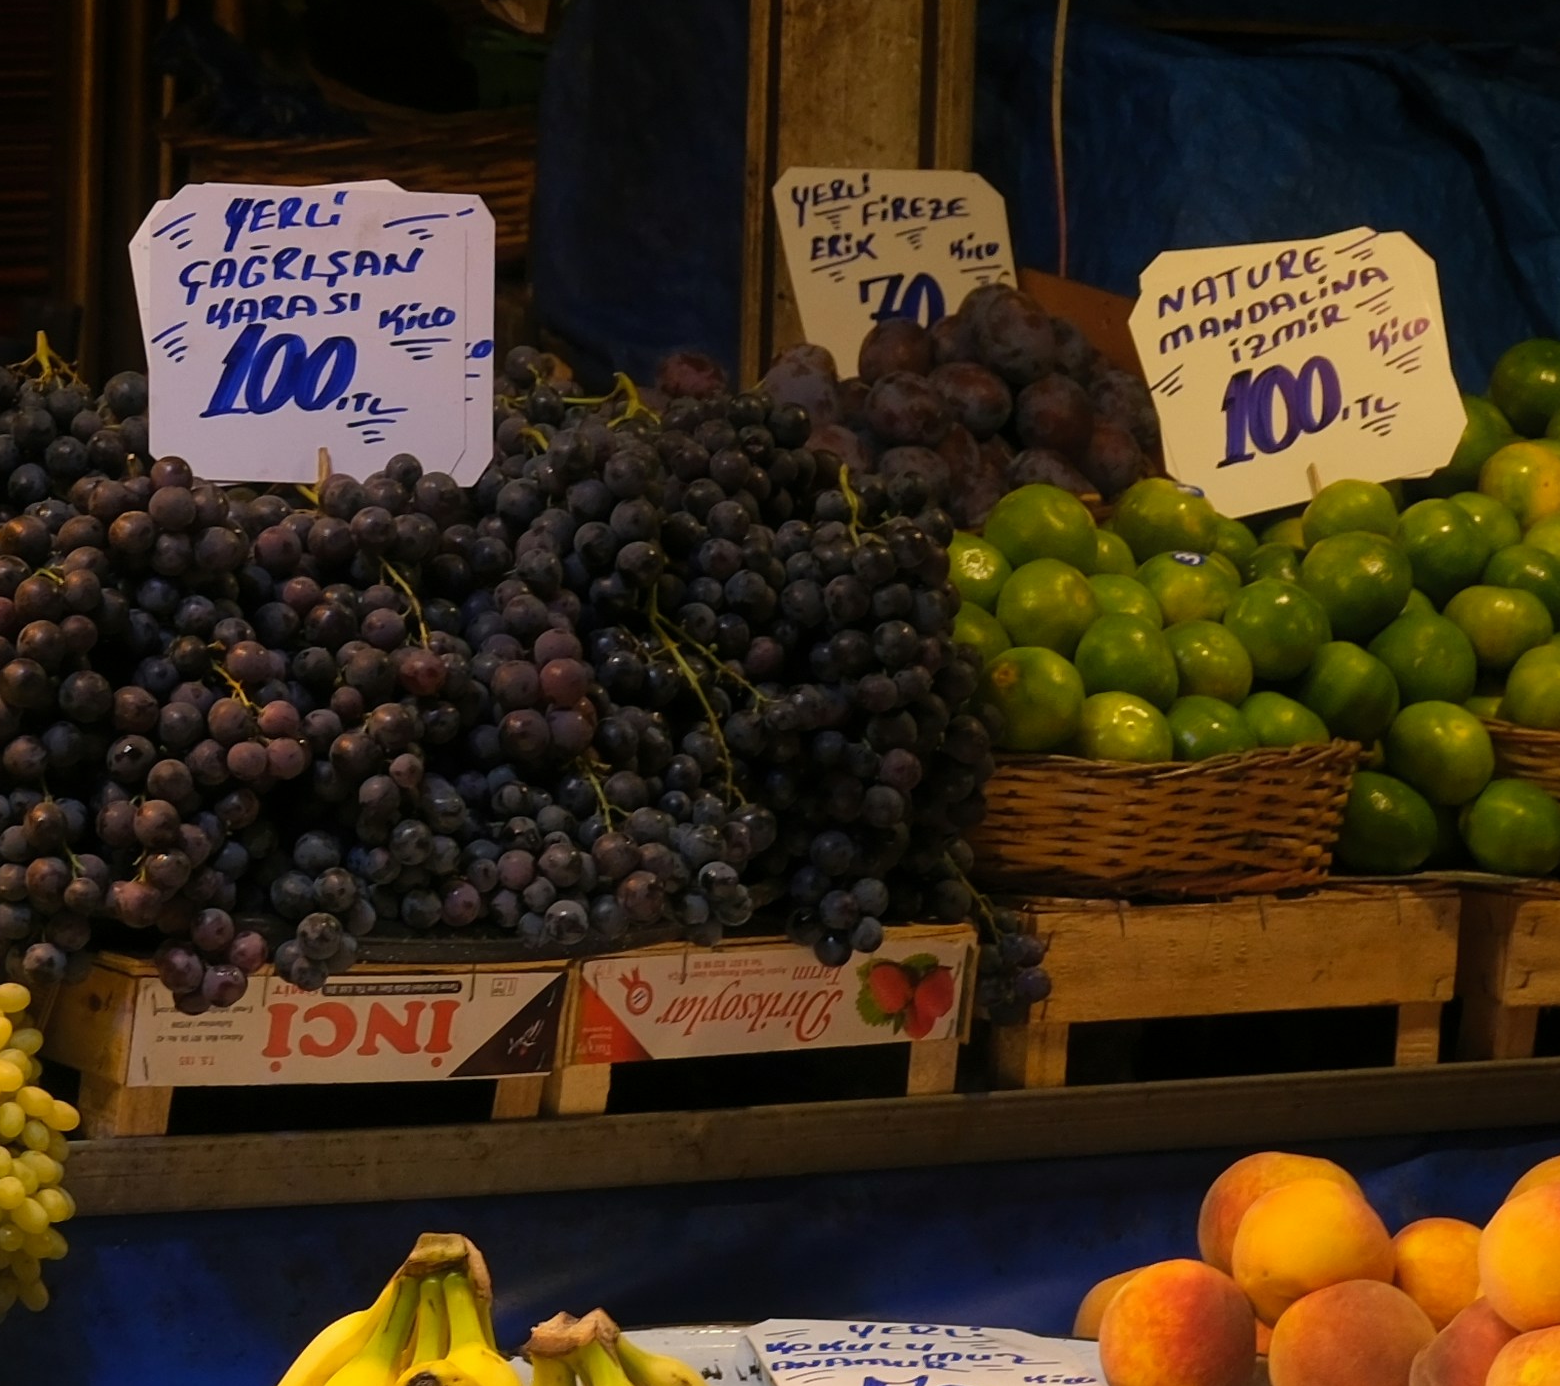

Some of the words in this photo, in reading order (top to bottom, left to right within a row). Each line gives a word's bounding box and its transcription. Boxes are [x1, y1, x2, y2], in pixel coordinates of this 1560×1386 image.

[224, 191, 348, 252] YERLİ
[810, 232, 879, 261] ERİK
[206, 293, 362, 330] KARASI
[858, 272, 946, 330] 70
[1157, 245, 1329, 319] NATURE
[1159, 266, 1390, 355] MANDALİNA
[1228, 304, 1352, 364] İZMİR
[199, 323, 358, 418] 100
[1216, 355, 1343, 469] 100
[261, 999, 460, 1073] İNCİ
[655, 980, 844, 1044] Diriksoylar
